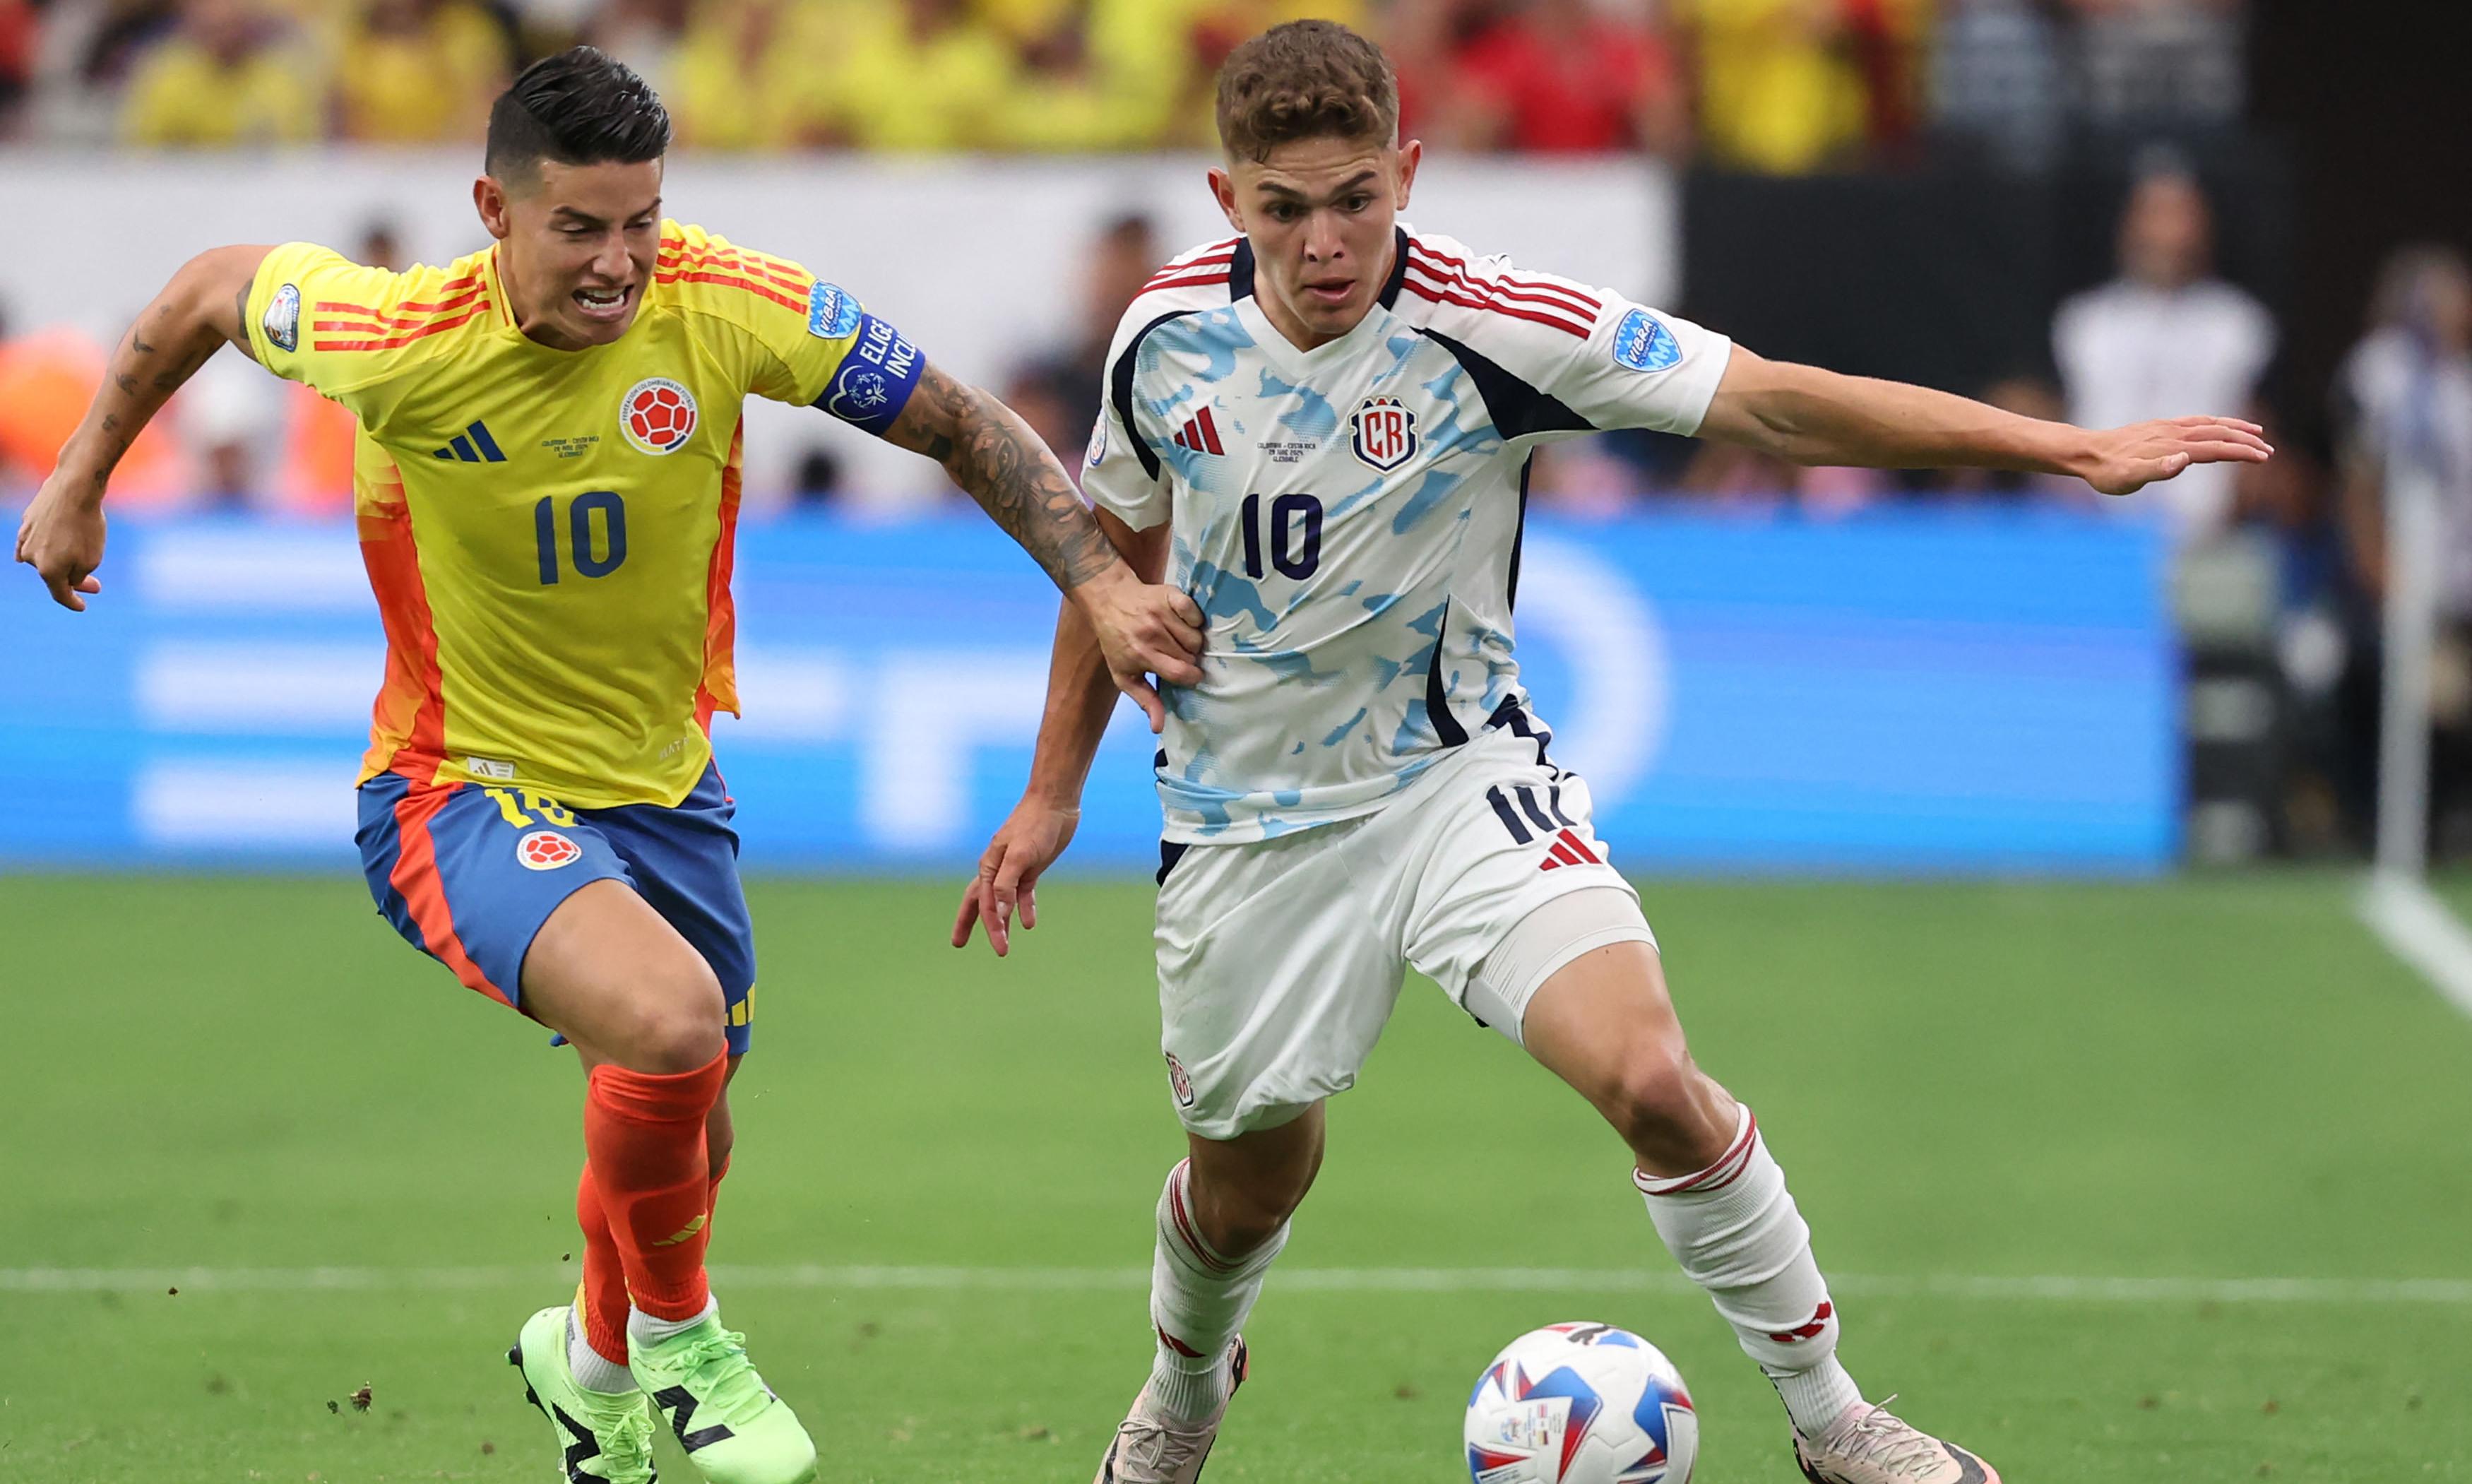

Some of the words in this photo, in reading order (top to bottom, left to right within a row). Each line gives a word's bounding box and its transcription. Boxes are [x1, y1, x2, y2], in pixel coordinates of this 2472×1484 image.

[820, 288, 837, 331] VIBRA
[859, 319, 893, 365] ELIGE
[1628, 319, 1653, 362] VIBRA
[1364, 410, 1403, 460] CR
[535, 491, 627, 585] 10
[1242, 493, 1323, 580] 10
[485, 788, 578, 829] 10
